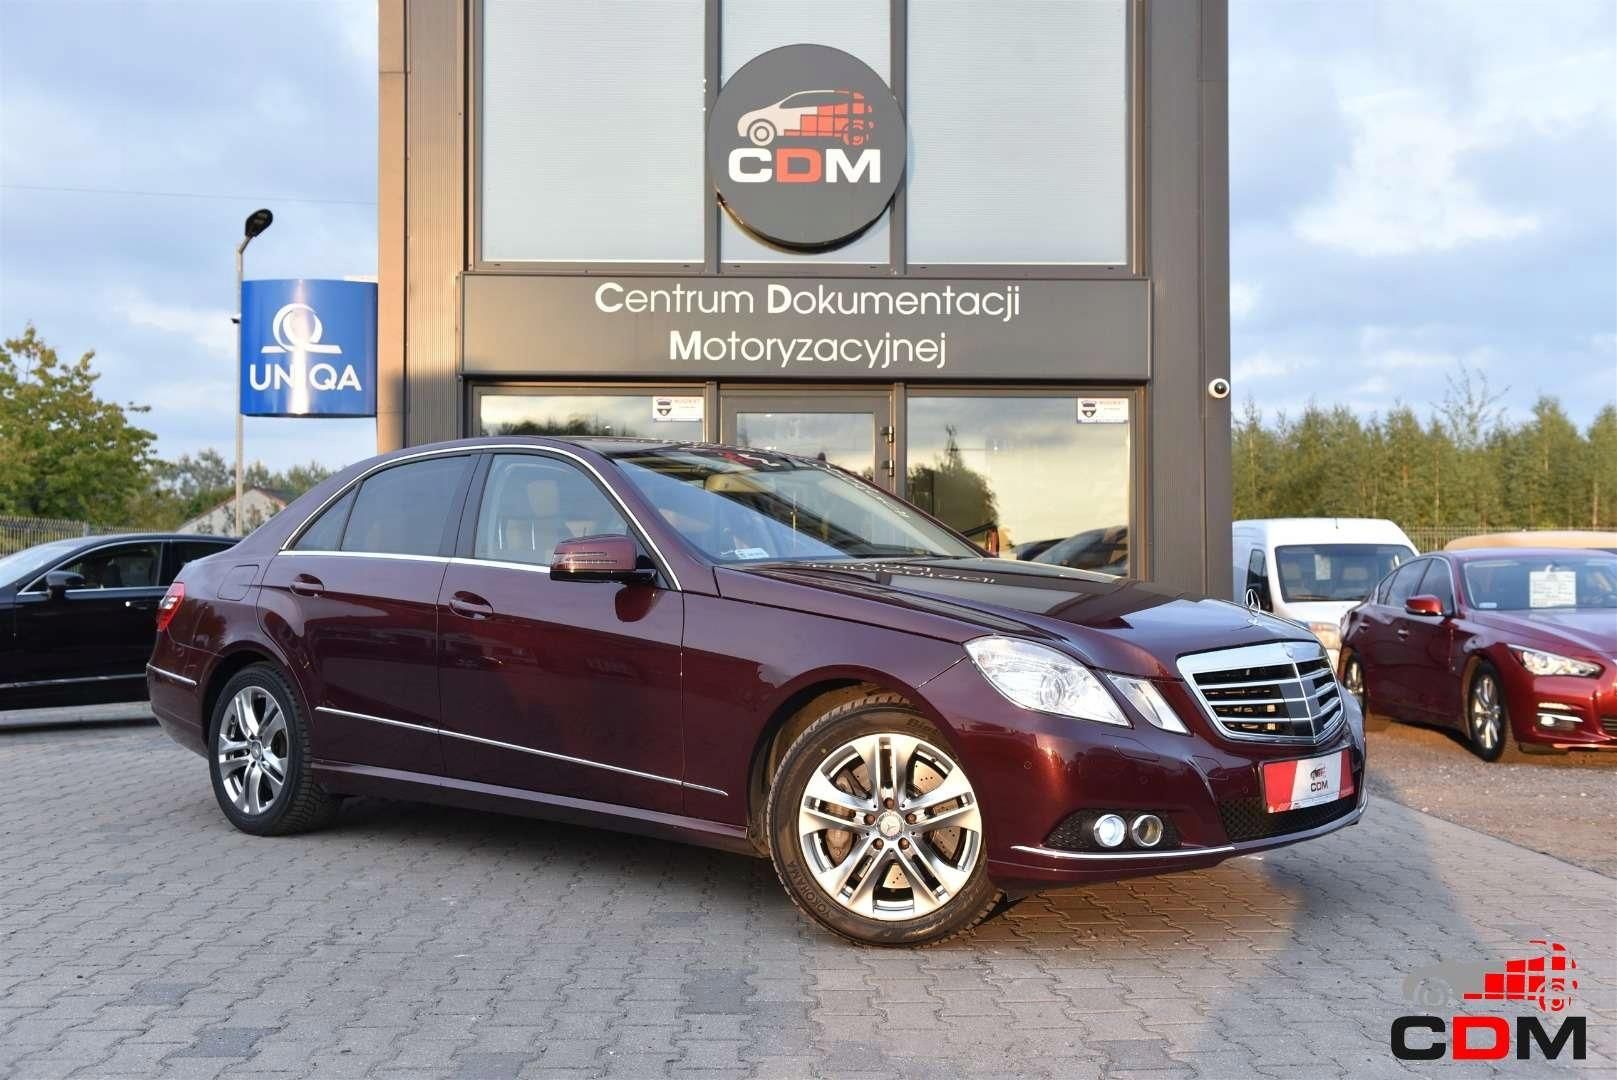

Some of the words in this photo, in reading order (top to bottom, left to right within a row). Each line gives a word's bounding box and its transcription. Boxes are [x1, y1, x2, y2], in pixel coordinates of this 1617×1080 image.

[728, 147, 882, 185] CDM
[594, 281, 755, 315] Centrum
[767, 283, 1021, 323] Dokumentacji
[669, 330, 947, 369] Motoryzacyjnej
[249, 363, 362, 391] UNQA
[1310, 780, 1329, 793] CDM
